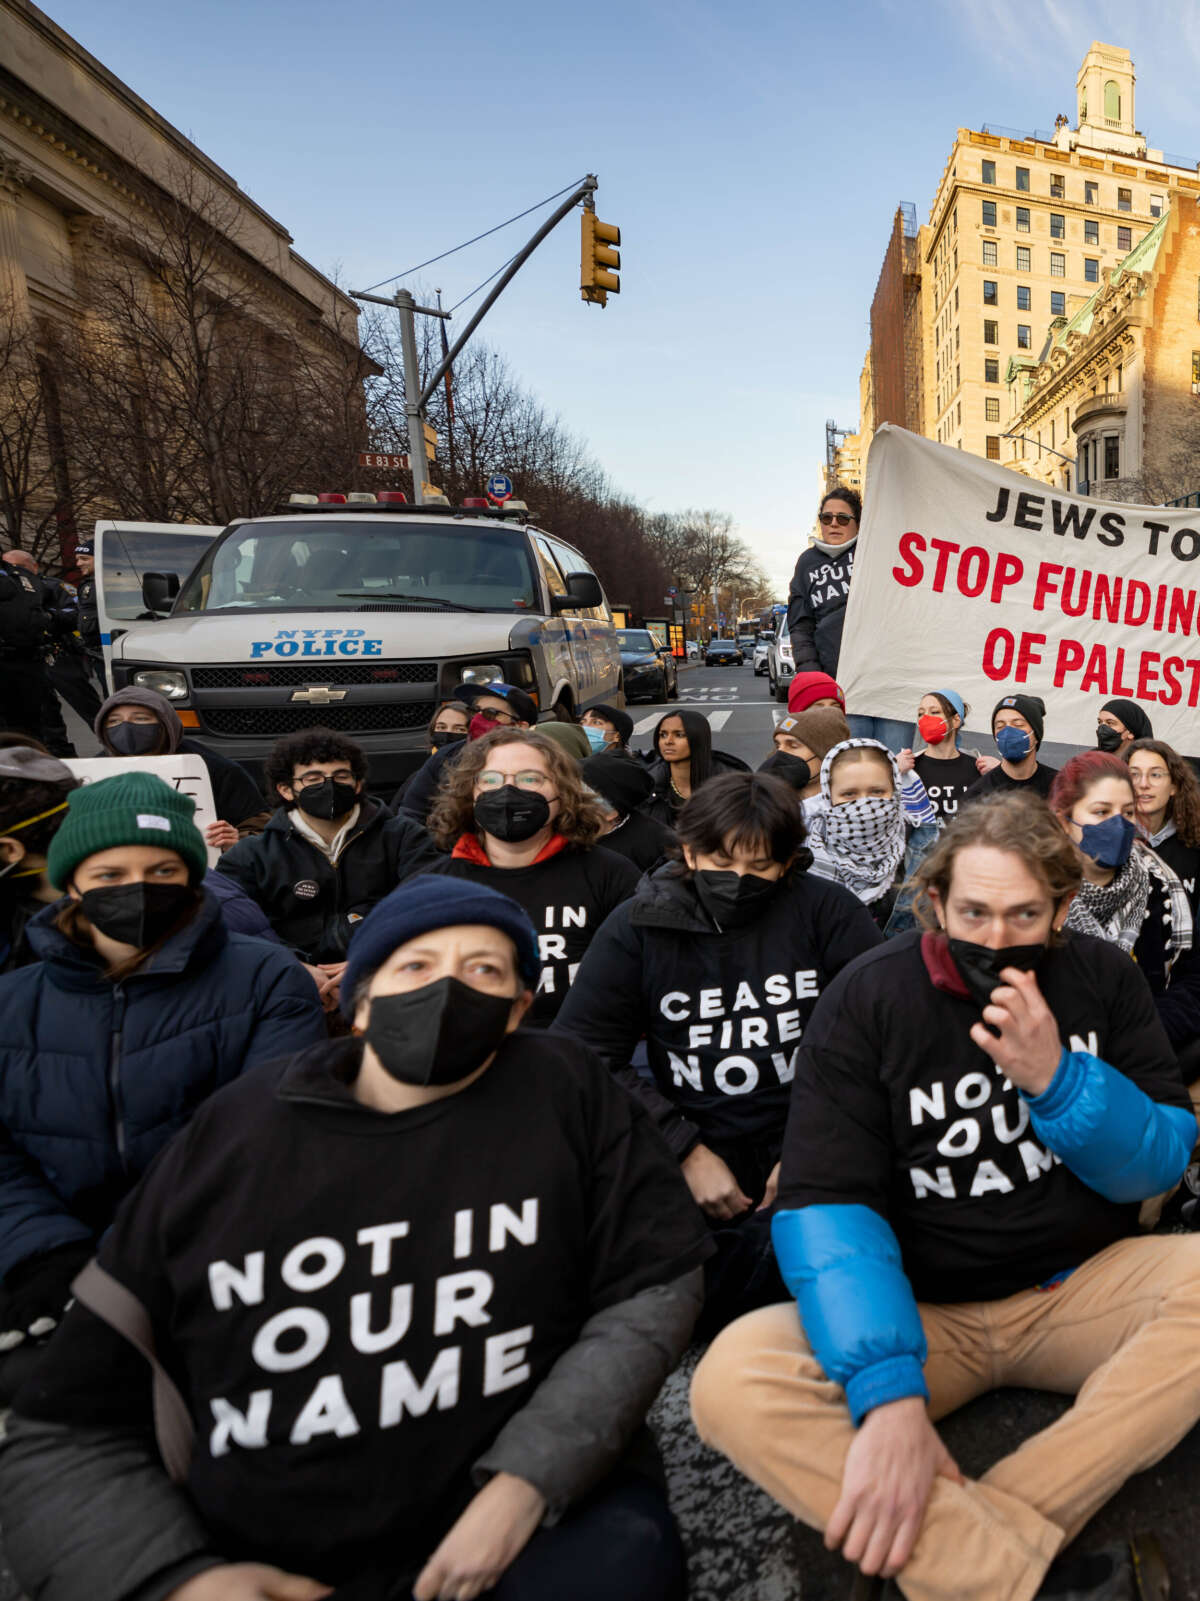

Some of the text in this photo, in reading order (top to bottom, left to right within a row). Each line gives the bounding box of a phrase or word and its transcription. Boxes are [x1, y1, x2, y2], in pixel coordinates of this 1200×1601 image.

[365, 455, 372, 466] E
[376, 456, 389, 467] 83
[986, 487, 1126, 547] JEWS
[808, 562, 838, 583] NO
[892, 532, 1024, 604] STOP
[251, 639, 383, 659] POLICE
[274, 629, 366, 640] NYPD
[982, 628, 1046, 681] OF
[928, 785, 954, 798] OT
[545, 905, 586, 929] IN
[660, 969, 820, 1022] CEASE
[689, 1009, 802, 1049] FIRE
[909, 1064, 1014, 1126] NO
[936, 1098, 1029, 1158] OU
[909, 1140, 1063, 1199] NAM
[208, 1198, 539, 1311] NOT IN
[252, 1269, 494, 1374] OUR
[210, 1324, 534, 1458] NAME
